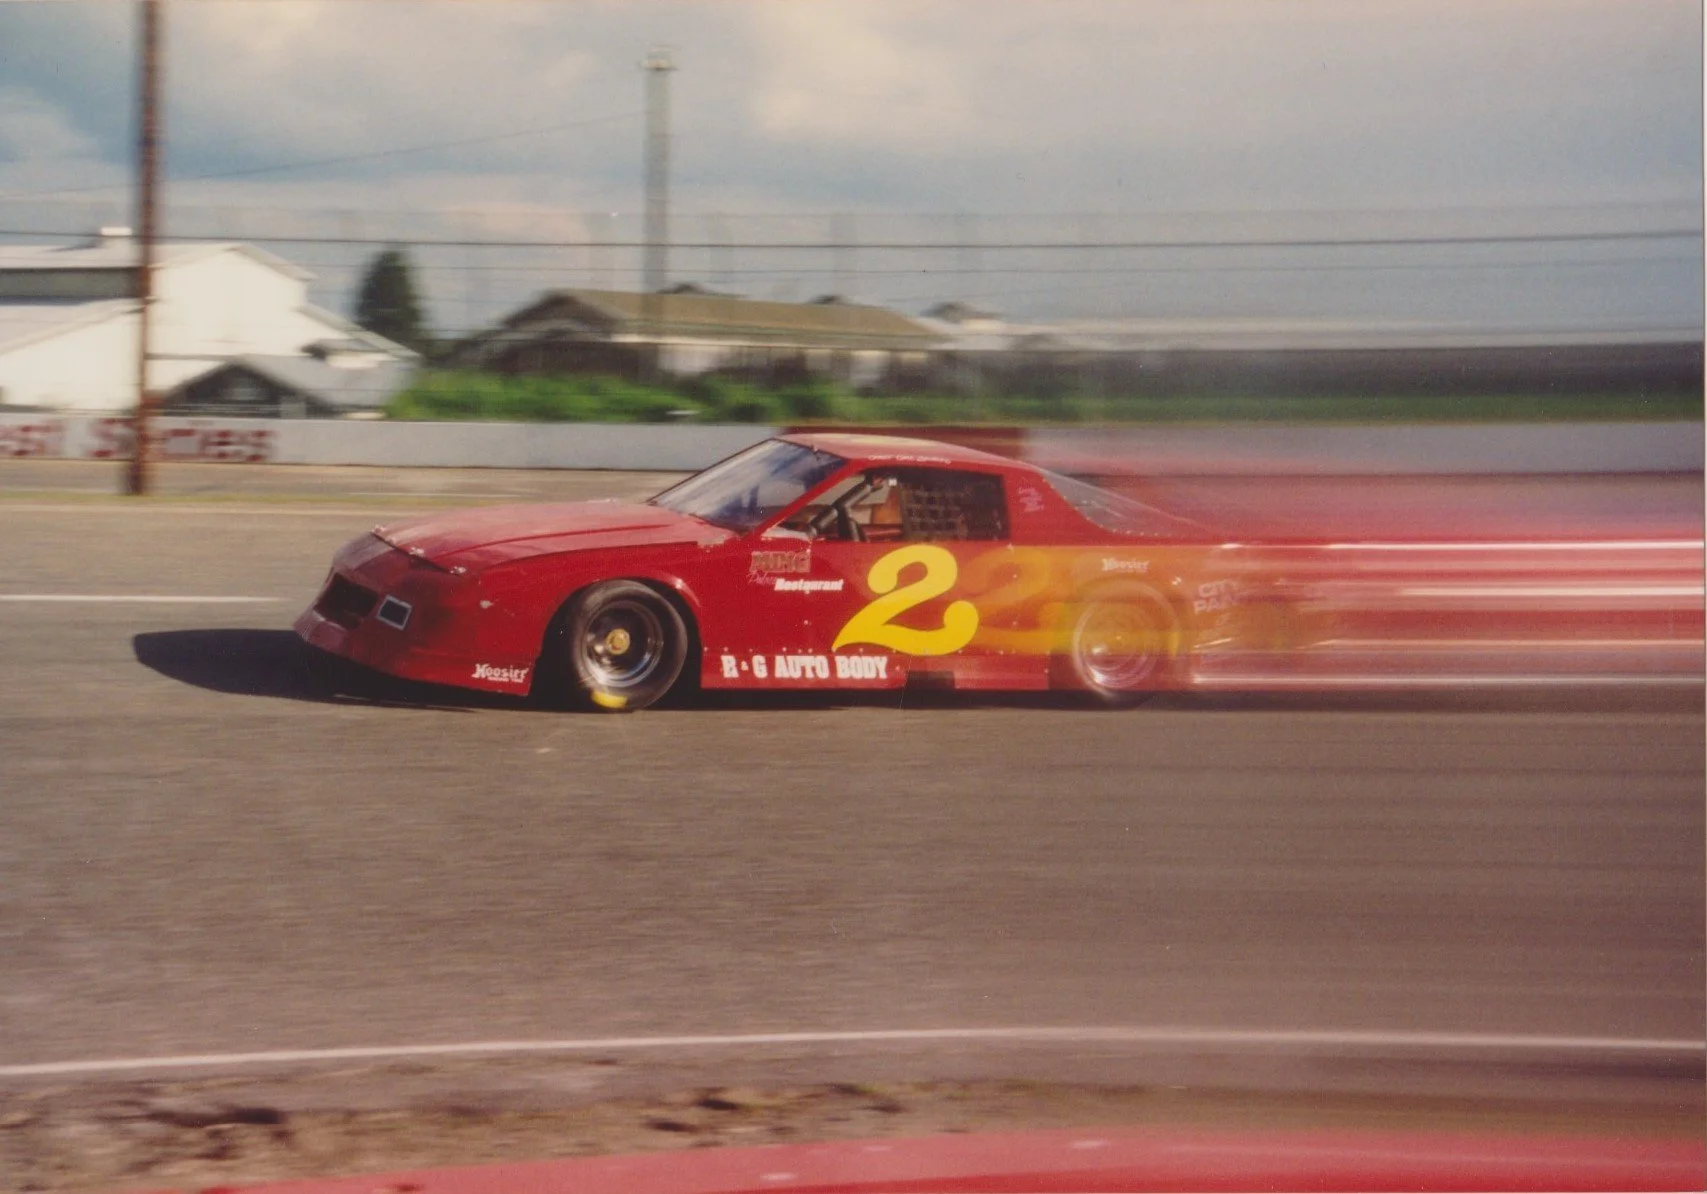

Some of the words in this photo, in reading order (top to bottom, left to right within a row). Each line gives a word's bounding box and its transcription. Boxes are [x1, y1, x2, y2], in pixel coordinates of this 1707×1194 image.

[774, 578, 844, 594] Restaurant
[832, 543, 980, 656] 2
[471, 663, 529, 679] Hoosier
[721, 655, 739, 678] R
[752, 655, 768, 678] G
[775, 655, 830, 679] AUTO
[835, 655, 888, 679] BODY
